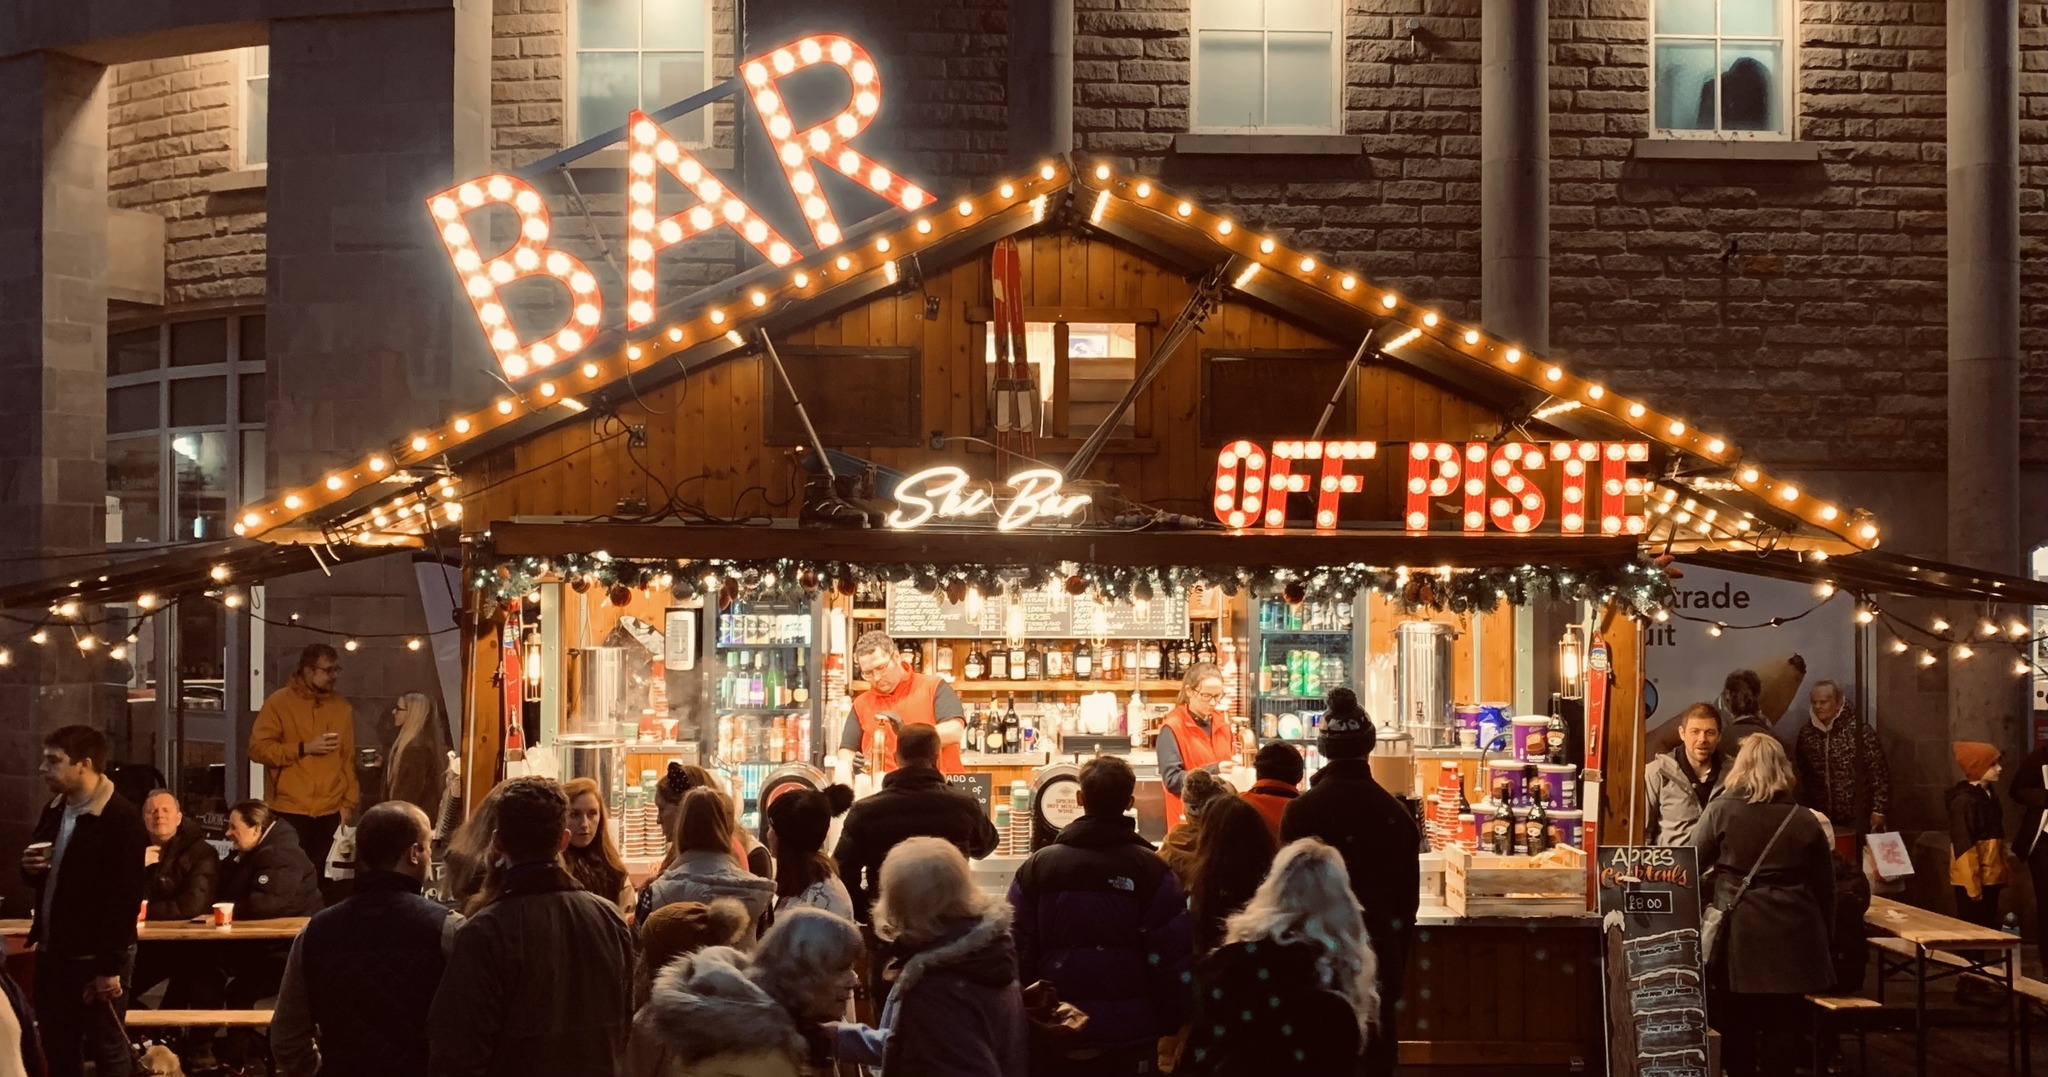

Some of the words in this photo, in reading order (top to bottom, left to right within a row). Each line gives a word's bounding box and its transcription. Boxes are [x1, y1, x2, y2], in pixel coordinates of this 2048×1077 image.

[425, 33, 937, 382] BAR
[889, 466, 993, 529] Ski
[998, 469, 1093, 531] Bar
[1214, 440, 1377, 529] OFF
[1406, 441, 1650, 535] PISTE
[947, 774, 966, 783] ADD
[972, 785, 983, 795] of
[1601, 864, 1689, 888] Coktails
